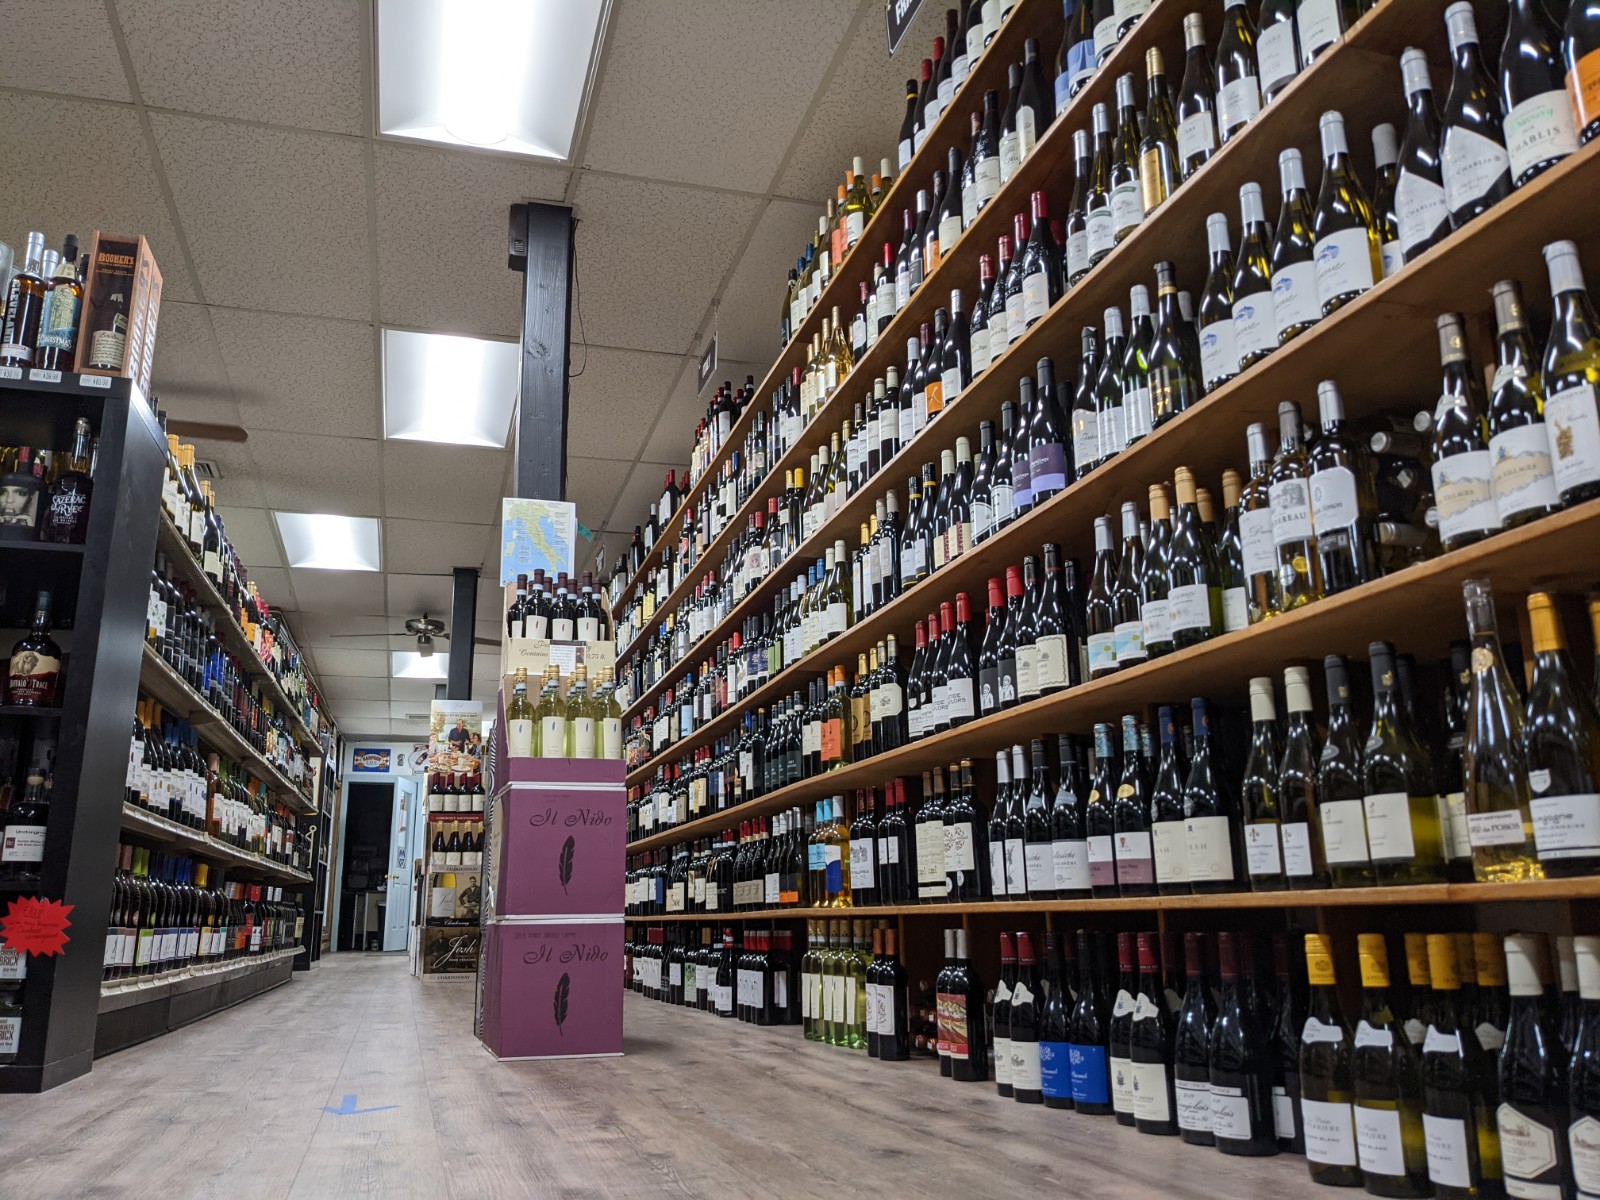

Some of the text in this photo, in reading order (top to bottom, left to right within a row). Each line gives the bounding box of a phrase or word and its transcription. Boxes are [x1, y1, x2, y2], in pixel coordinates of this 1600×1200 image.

[1511, 127, 1560, 159] CHABLIS
[1456, 158, 1493, 175] CHABLIS
[98, 252, 135, 265] BOOKER'S
[51, 494, 87, 511] SAZERAC
[33, 678, 49, 690] TRACE
[529, 807, 613, 828] Il Nido
[433, 934, 477, 968] Josh
[523, 944, 609, 964] Il Nido
[0, 1031, 14, 1040] RICK
